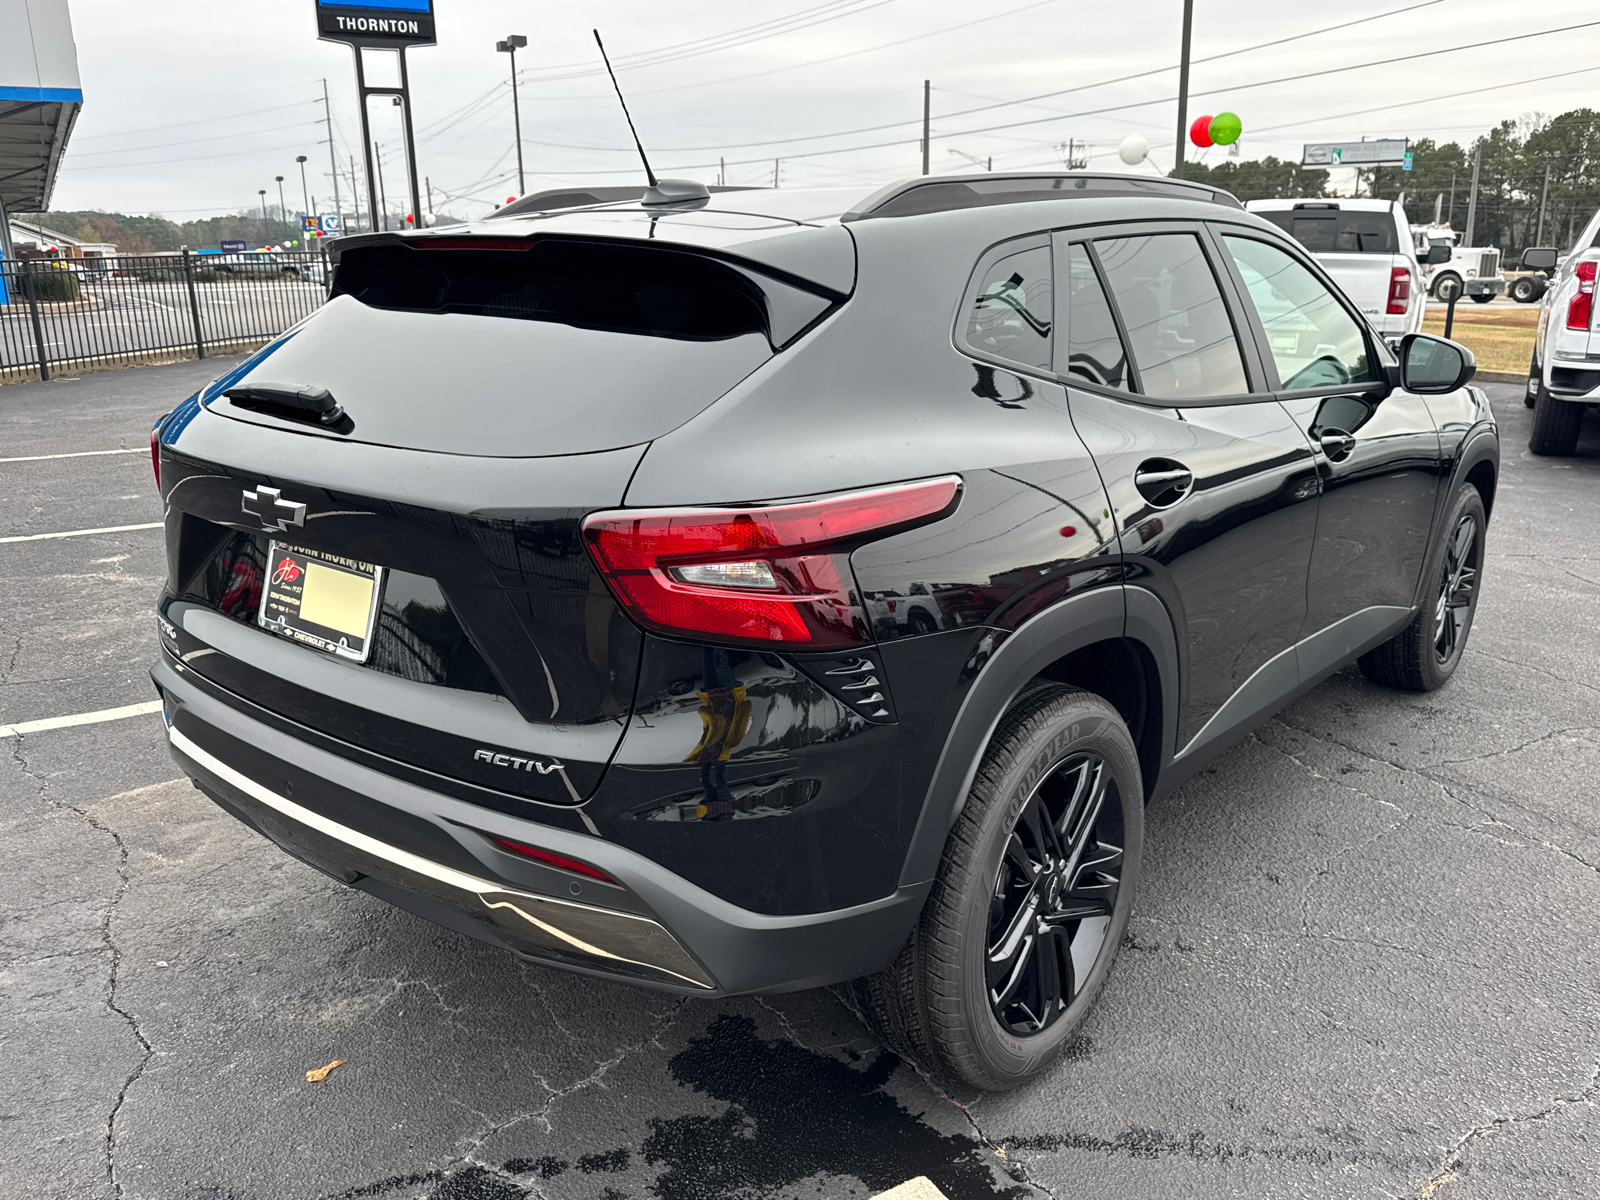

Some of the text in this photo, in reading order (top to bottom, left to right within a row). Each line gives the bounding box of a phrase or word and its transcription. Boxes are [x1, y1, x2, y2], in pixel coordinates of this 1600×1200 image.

[336, 16, 418, 34] THORNTON
[320, 552, 374, 573] THORNON
[294, 631, 326, 647] CHEVROLET
[473, 748, 566, 775] ACTIV
[1001, 722, 1081, 836] GOODYEAR
